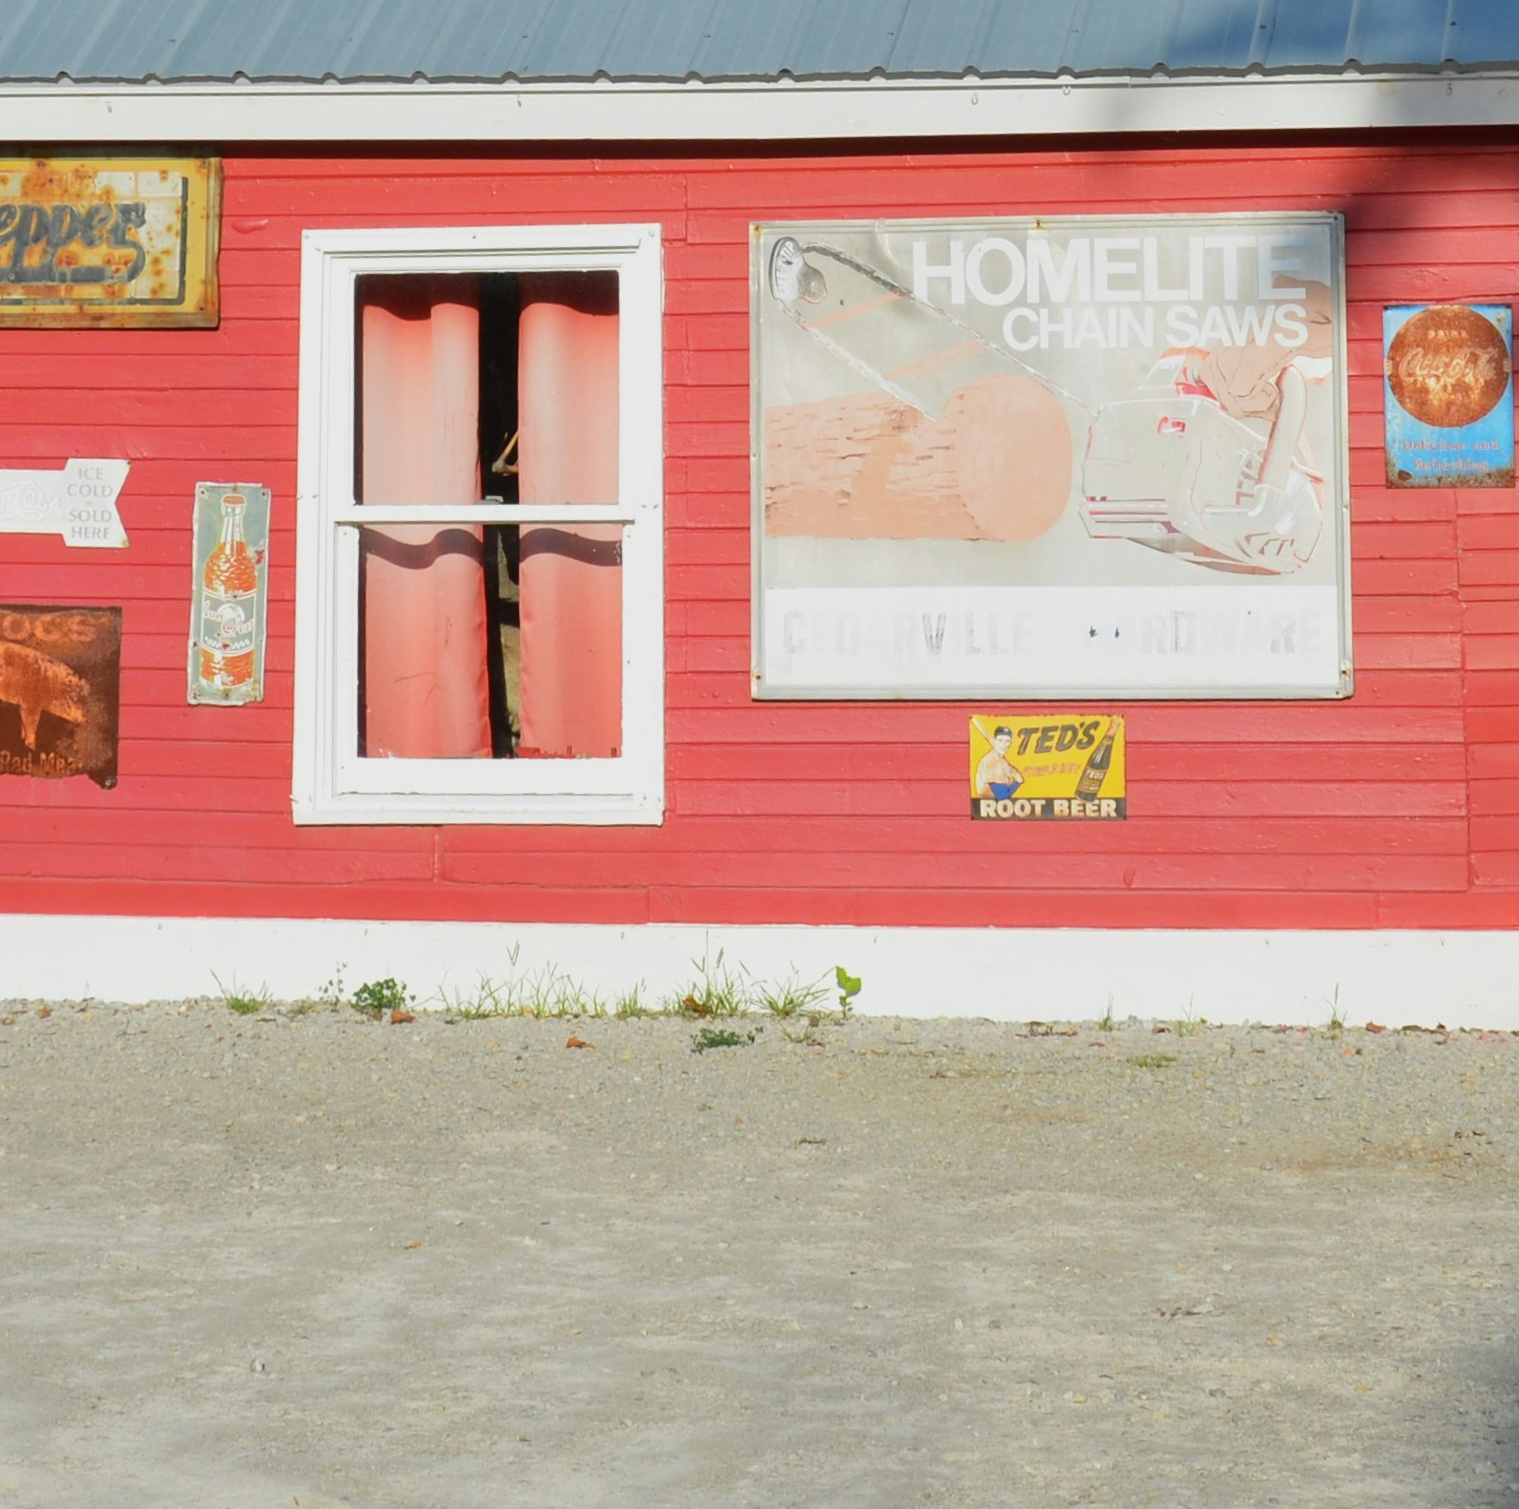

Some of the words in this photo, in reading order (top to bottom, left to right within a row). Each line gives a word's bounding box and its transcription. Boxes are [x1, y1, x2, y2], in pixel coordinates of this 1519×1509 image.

[912, 236, 1306, 307] HOMELITE
[1002, 304, 1154, 352] CHAIN
[1165, 303, 1309, 349] SAWS
[78, 468, 104, 481] ICE
[67, 484, 113, 499] COLD
[69, 509, 113, 523] SOLD
[71, 527, 111, 540] HERE
[1017, 720, 1100, 756] TED'S
[981, 799, 1046, 818] ROOT
[1053, 799, 1117, 818] BEER
